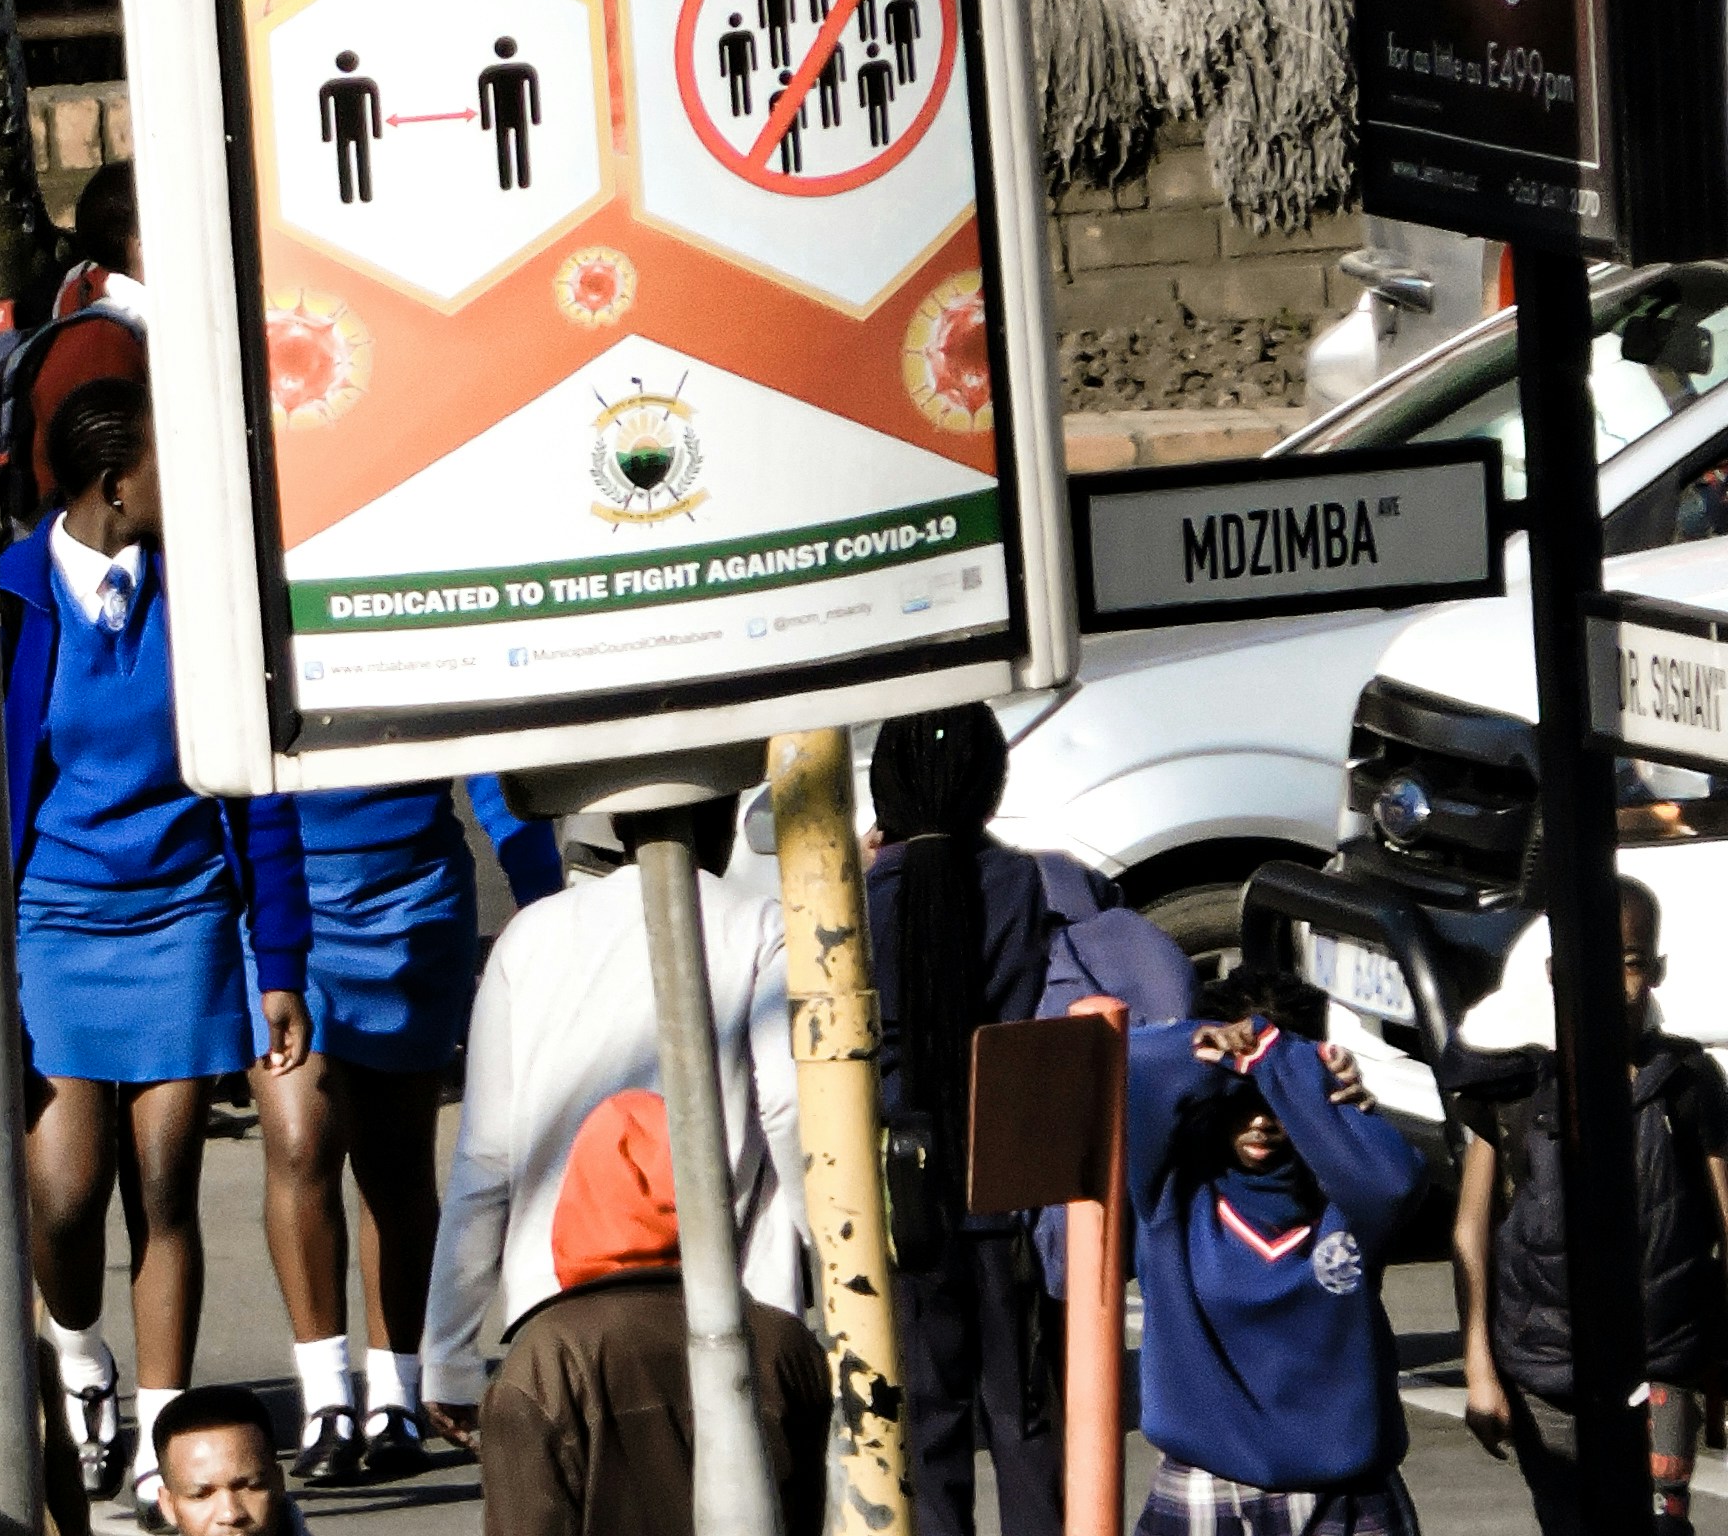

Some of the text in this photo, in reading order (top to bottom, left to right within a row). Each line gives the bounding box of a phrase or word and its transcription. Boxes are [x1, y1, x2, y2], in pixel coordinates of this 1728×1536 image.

[330, 516, 958, 621] DEDICATED TO THE FIGHT AGAINST COVID-19
[1181, 495, 1401, 584] MDZIMBA AVE
